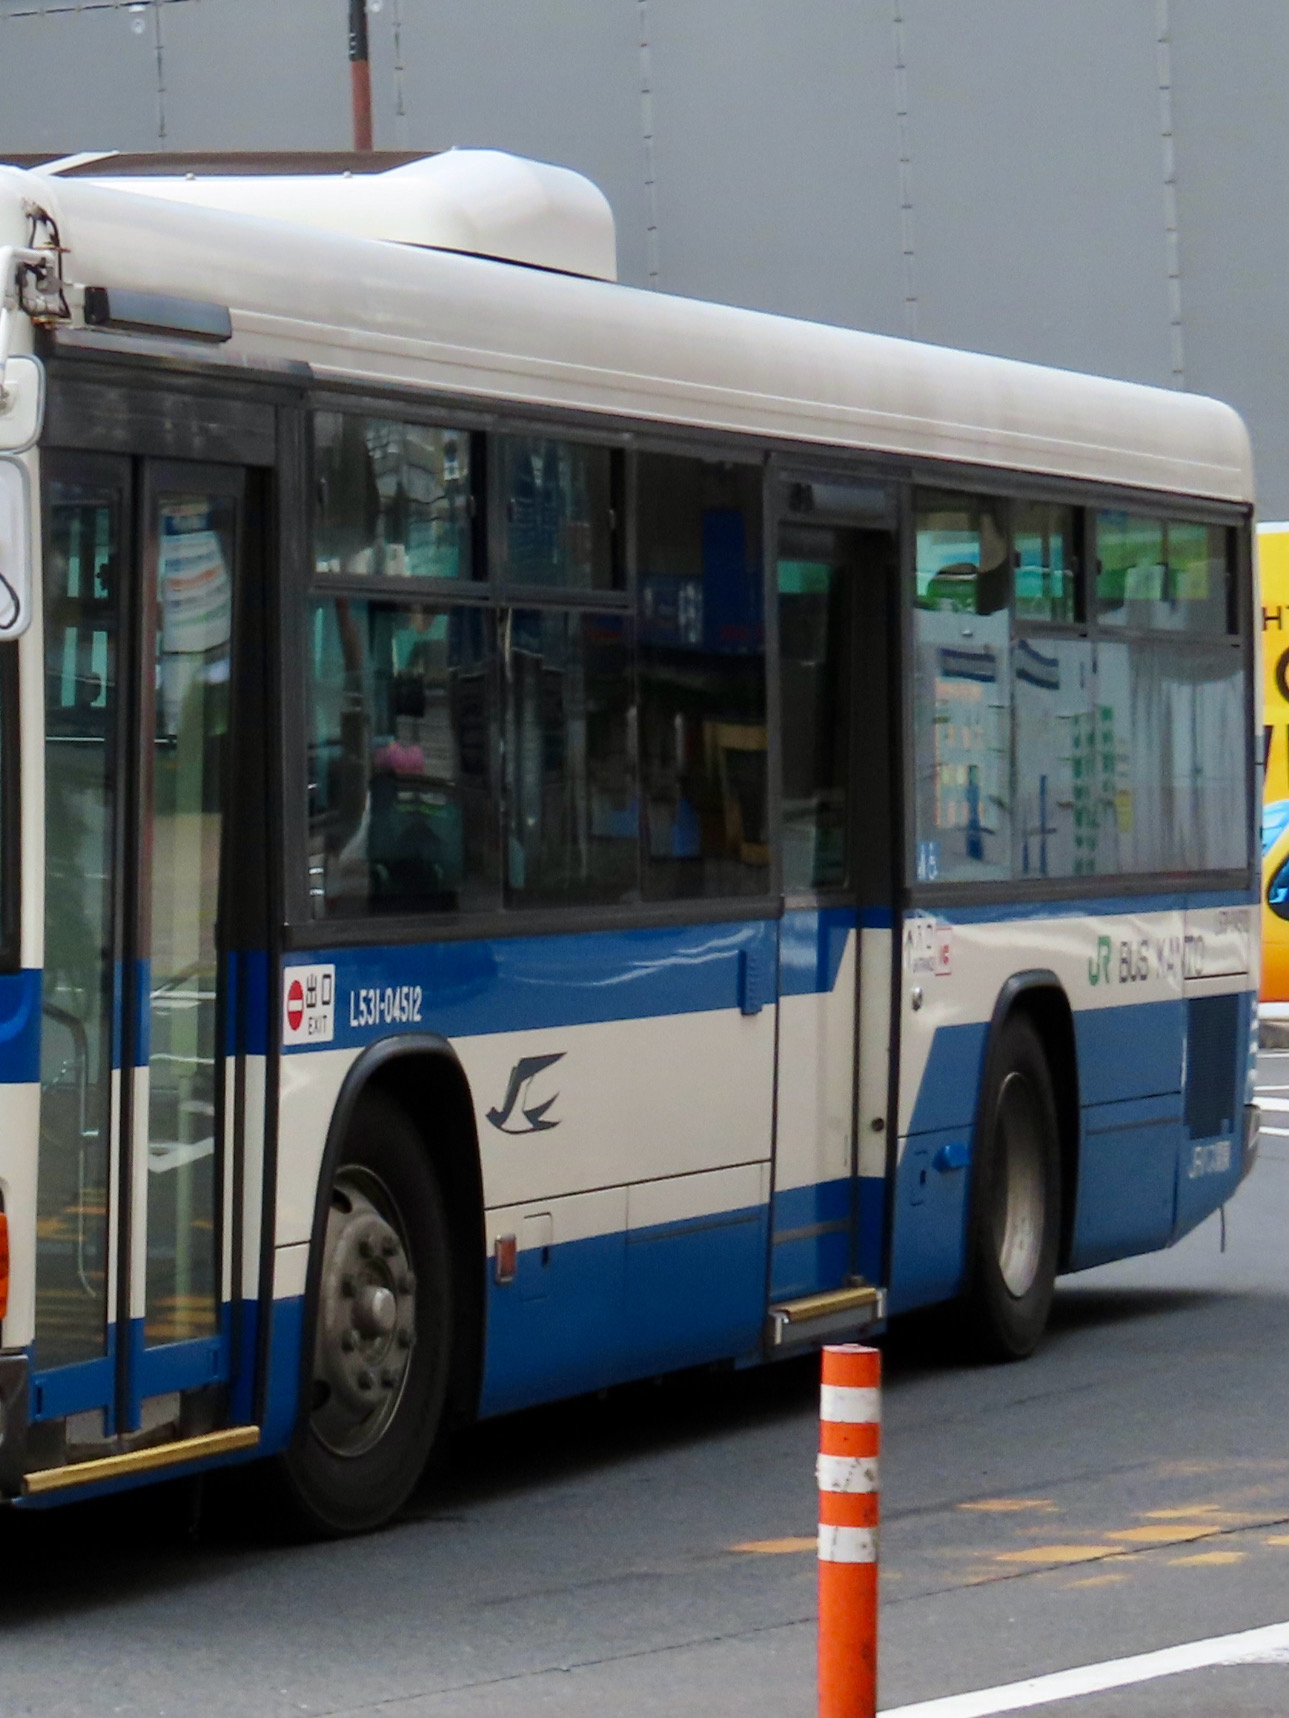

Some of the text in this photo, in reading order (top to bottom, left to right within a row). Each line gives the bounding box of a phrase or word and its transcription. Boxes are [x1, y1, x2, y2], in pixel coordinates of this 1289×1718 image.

[1088, 935, 1111, 986] JR
[1119, 938, 1149, 984] BUS
[305, 972, 332, 1009] 出口
[349, 984, 423, 1028] L531-04512
